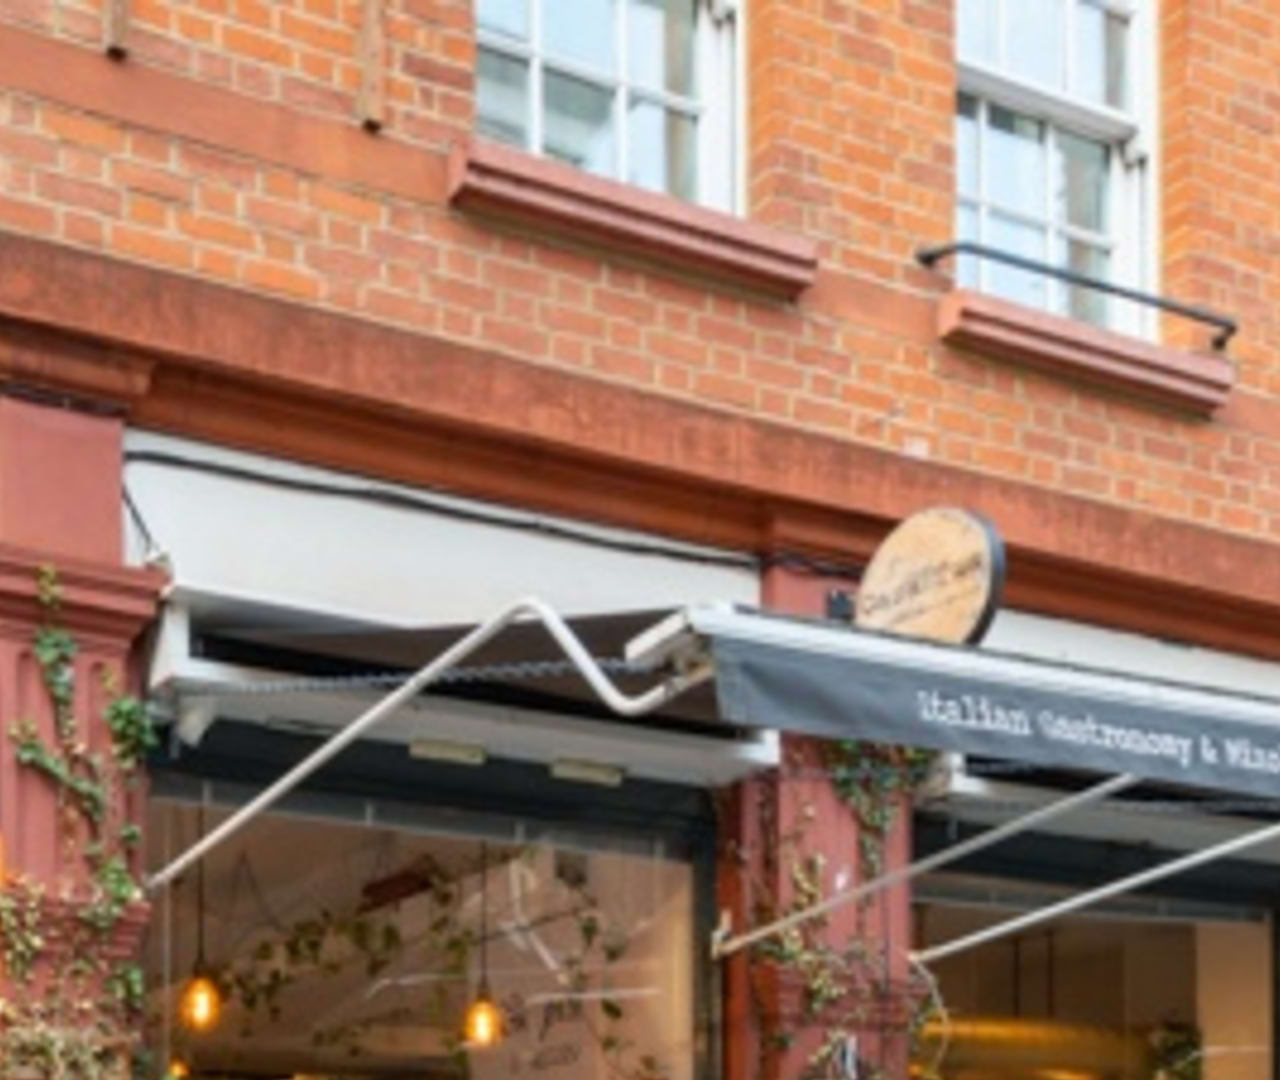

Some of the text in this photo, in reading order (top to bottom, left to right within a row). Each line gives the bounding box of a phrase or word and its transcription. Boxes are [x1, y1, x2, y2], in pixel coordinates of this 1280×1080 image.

[917, 688, 1033, 737] Italian
[1037, 709, 1192, 769] Gastronomy
[1200, 733, 1219, 764] &
